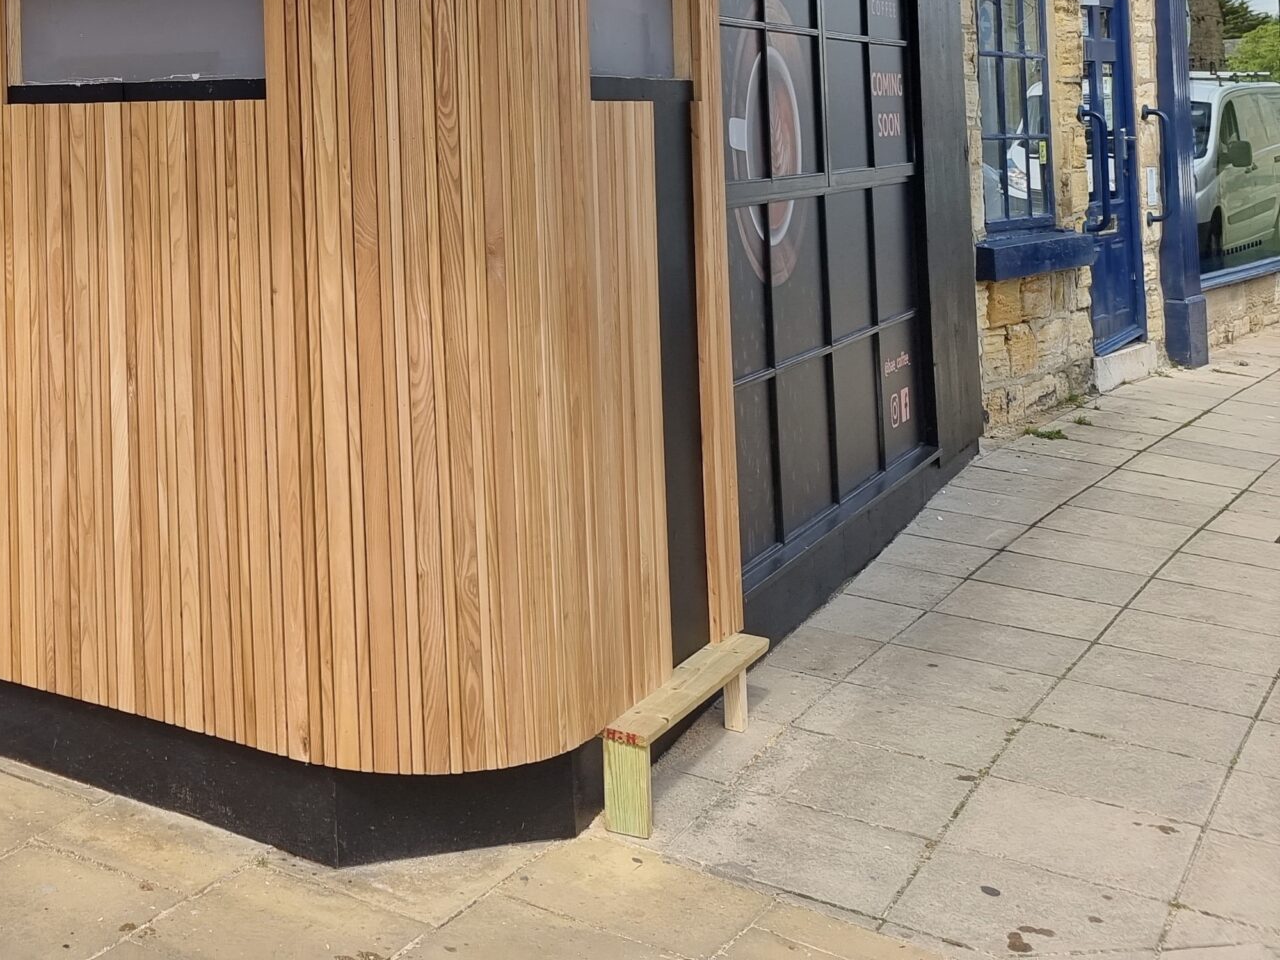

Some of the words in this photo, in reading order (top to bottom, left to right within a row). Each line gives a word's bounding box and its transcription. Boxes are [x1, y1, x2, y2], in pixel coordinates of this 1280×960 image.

[871, 0, 896, 19] COFFEE
[871, 72, 903, 97] COMING
[878, 112, 901, 137] SOON
